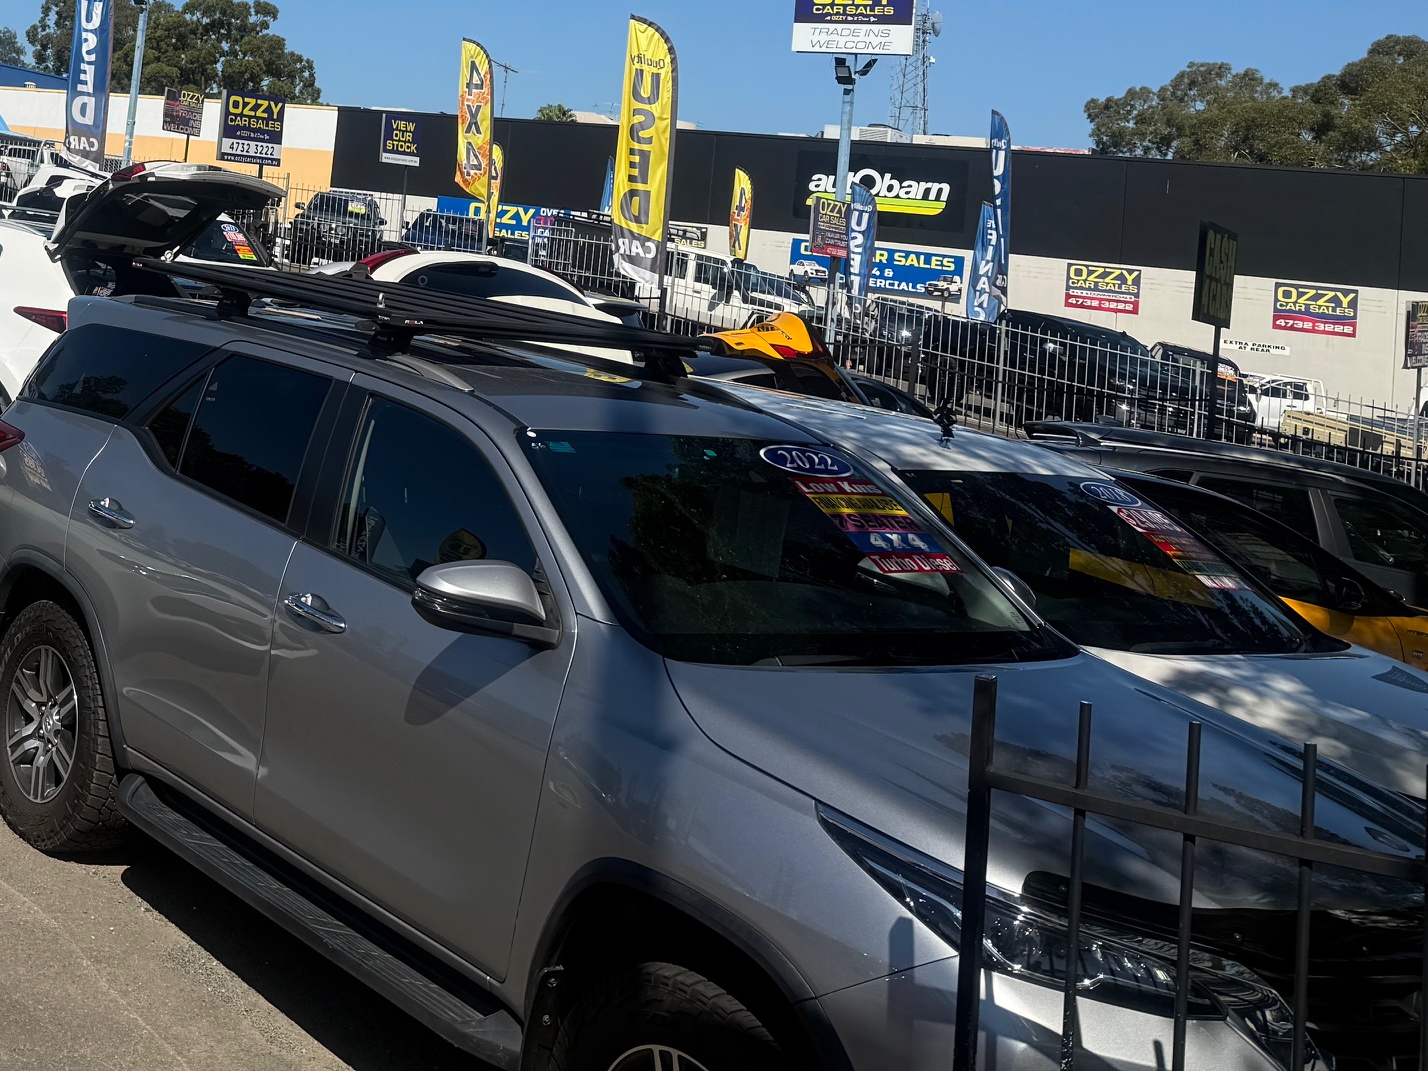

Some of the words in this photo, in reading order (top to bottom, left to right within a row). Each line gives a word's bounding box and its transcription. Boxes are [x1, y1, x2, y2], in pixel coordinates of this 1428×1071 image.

[813, 6, 843, 14] CAR
[846, 6, 894, 15] SALES
[811, 27, 862, 37] TRADE
[864, 28, 892, 38] INS
[810, 39, 893, 50] WELCOME
[181, 91, 204, 103] OZZY
[229, 95, 283, 119] OZZY
[179, 110, 202, 120] TRADE
[163, 122, 200, 136] WELCOME
[189, 120, 200, 128] INS
[228, 115, 249, 128] CAR
[250, 118, 281, 131] SALES
[392, 119, 415, 131] VIEW
[393, 130, 412, 142] OUR
[229, 141, 250, 153] 4732
[254, 144, 275, 156] 3222
[386, 140, 417, 153] STOCK
[819, 199, 847, 218] OZZY
[818, 214, 830, 223] CAR
[830, 216, 846, 226] SALES
[493, 228, 530, 240] SALES
[674, 237, 705, 249] SALES
[894, 253, 955, 271] SALES
[1070, 265, 1140, 285] OZZY
[1069, 279, 1094, 288] CAR
[1098, 282, 1138, 293] SALES
[1068, 298, 1099, 307] 4732
[1101, 301, 1133, 310] 3222
[1277, 287, 1357, 308] OZZY
[1277, 302, 1305, 311] CAR
[1310, 305, 1354, 316] SALES
[1276, 319, 1313, 329] 4732
[1315, 322, 1354, 334] 3222
[777, 449, 839, 471] 2022
[794, 480, 837, 494] Low
[846, 514, 923, 532] SEATER
[870, 555, 914, 571] Turbo
[913, 556, 961, 571] Diesel
